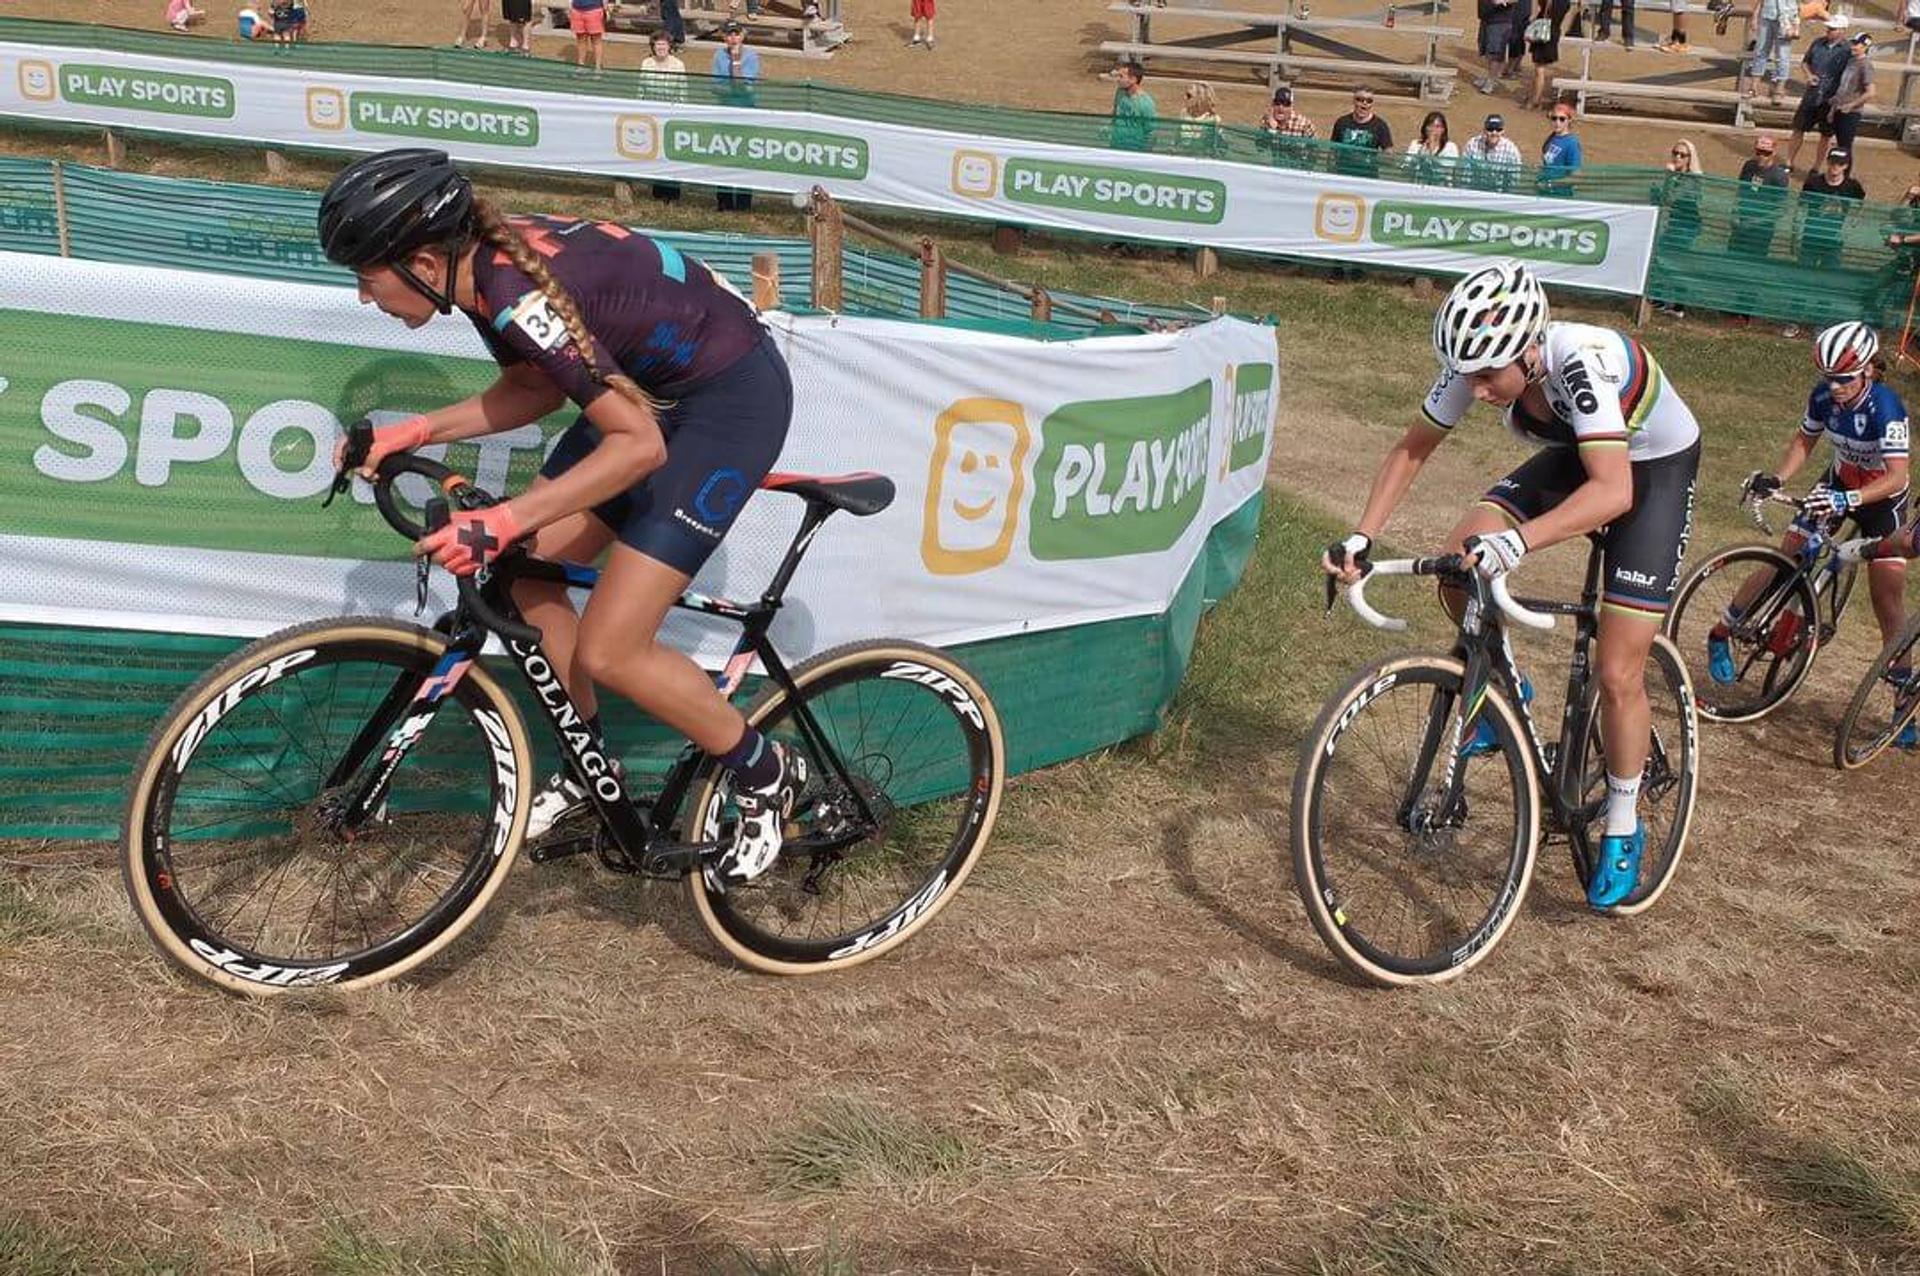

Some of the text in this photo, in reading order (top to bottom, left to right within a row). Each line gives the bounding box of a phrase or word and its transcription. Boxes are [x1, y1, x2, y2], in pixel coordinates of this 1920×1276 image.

[67, 74, 226, 108] PLAY SPORTS
[358, 102, 530, 136] PLAY SPORTS
[674, 131, 859, 169] PLAY SPORTS
[1014, 169, 1215, 213] PLAY SPORTS
[1383, 212, 1597, 255] PLAY SPORTS
[1052, 437, 1176, 519] PLAY
[172, 649, 316, 774] ZIPP
[881, 661, 984, 730] ZIPP
[473, 708, 517, 857] ZIPP
[828, 869, 948, 961] ZIPP
[190, 938, 350, 988] ZIPP
